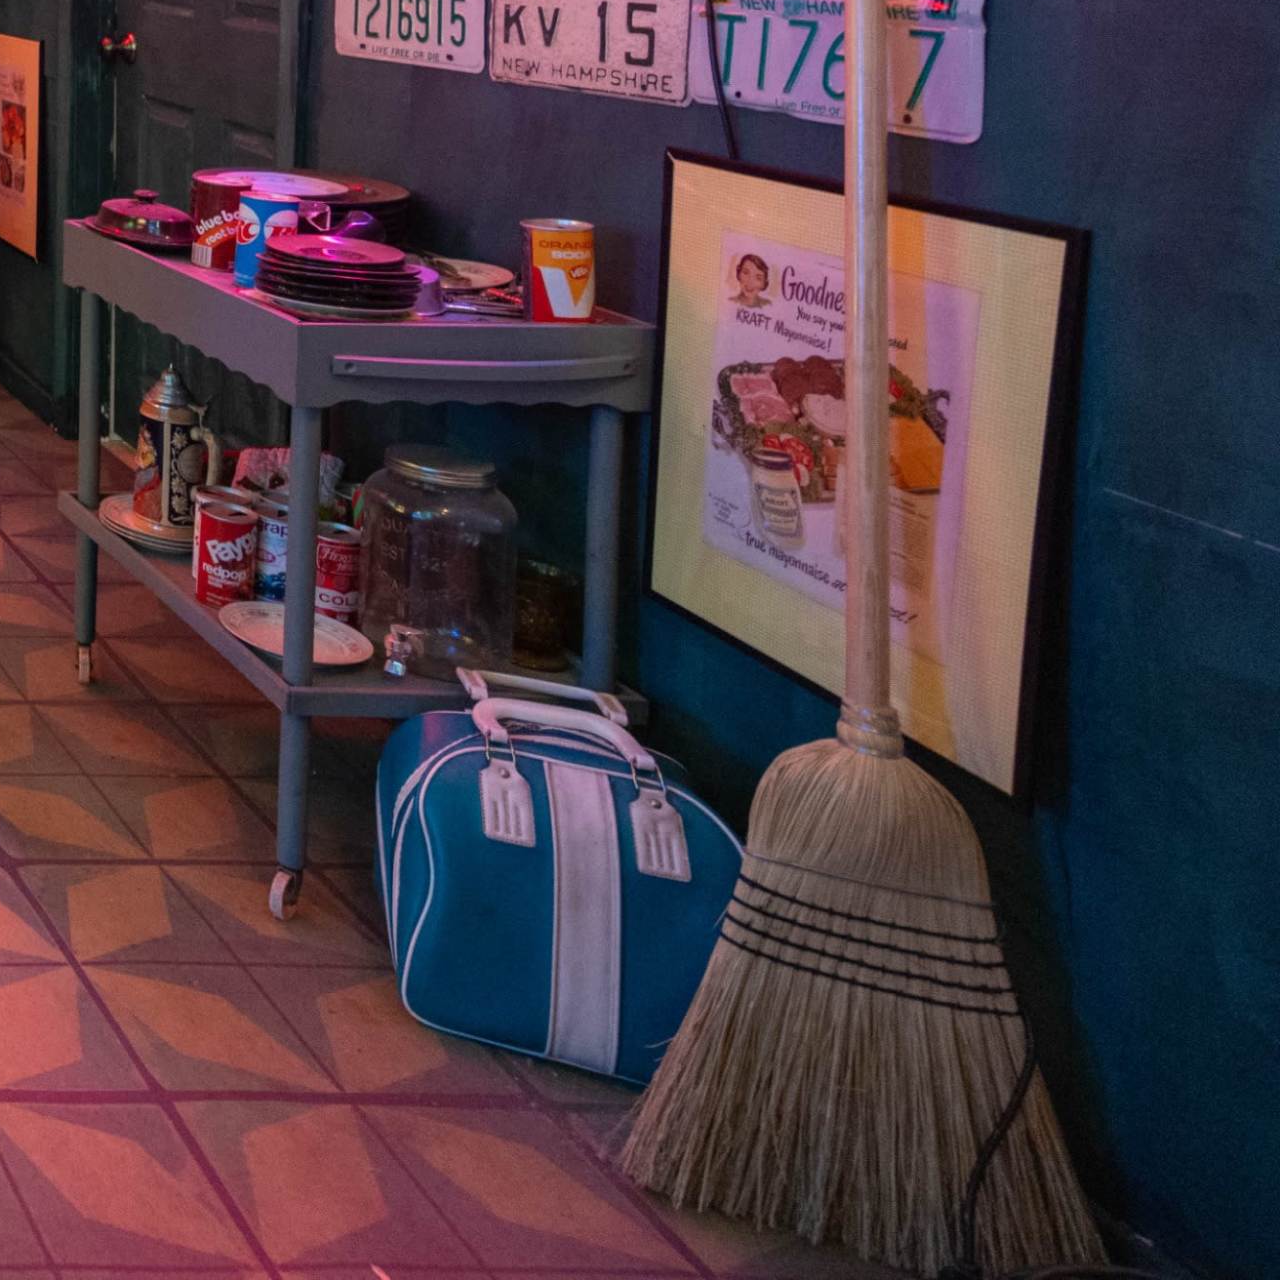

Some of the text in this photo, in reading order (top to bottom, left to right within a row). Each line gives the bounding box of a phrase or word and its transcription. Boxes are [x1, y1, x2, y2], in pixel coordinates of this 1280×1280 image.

[597, 1, 657, 67] 15
[372, 46, 388, 56] LIVE
[391, 48, 409, 57] FREE
[413, 50, 424, 60] OR
[716, 13, 946, 111] T1767
[502, 56, 673, 93] NEW HAMPSHIRE
[775, 98, 796, 111] Live
[801, 100, 824, 114] Free
[195, 214, 224, 235] blue
[781, 265, 845, 315] Goodne
[736, 307, 832, 353] KRAFT Mayonnaise!
[796, 306, 811, 322] You
[829, 319, 846, 333] you'
[262, 521, 288, 537] rap
[745, 531, 830, 585] true mayonnaise
